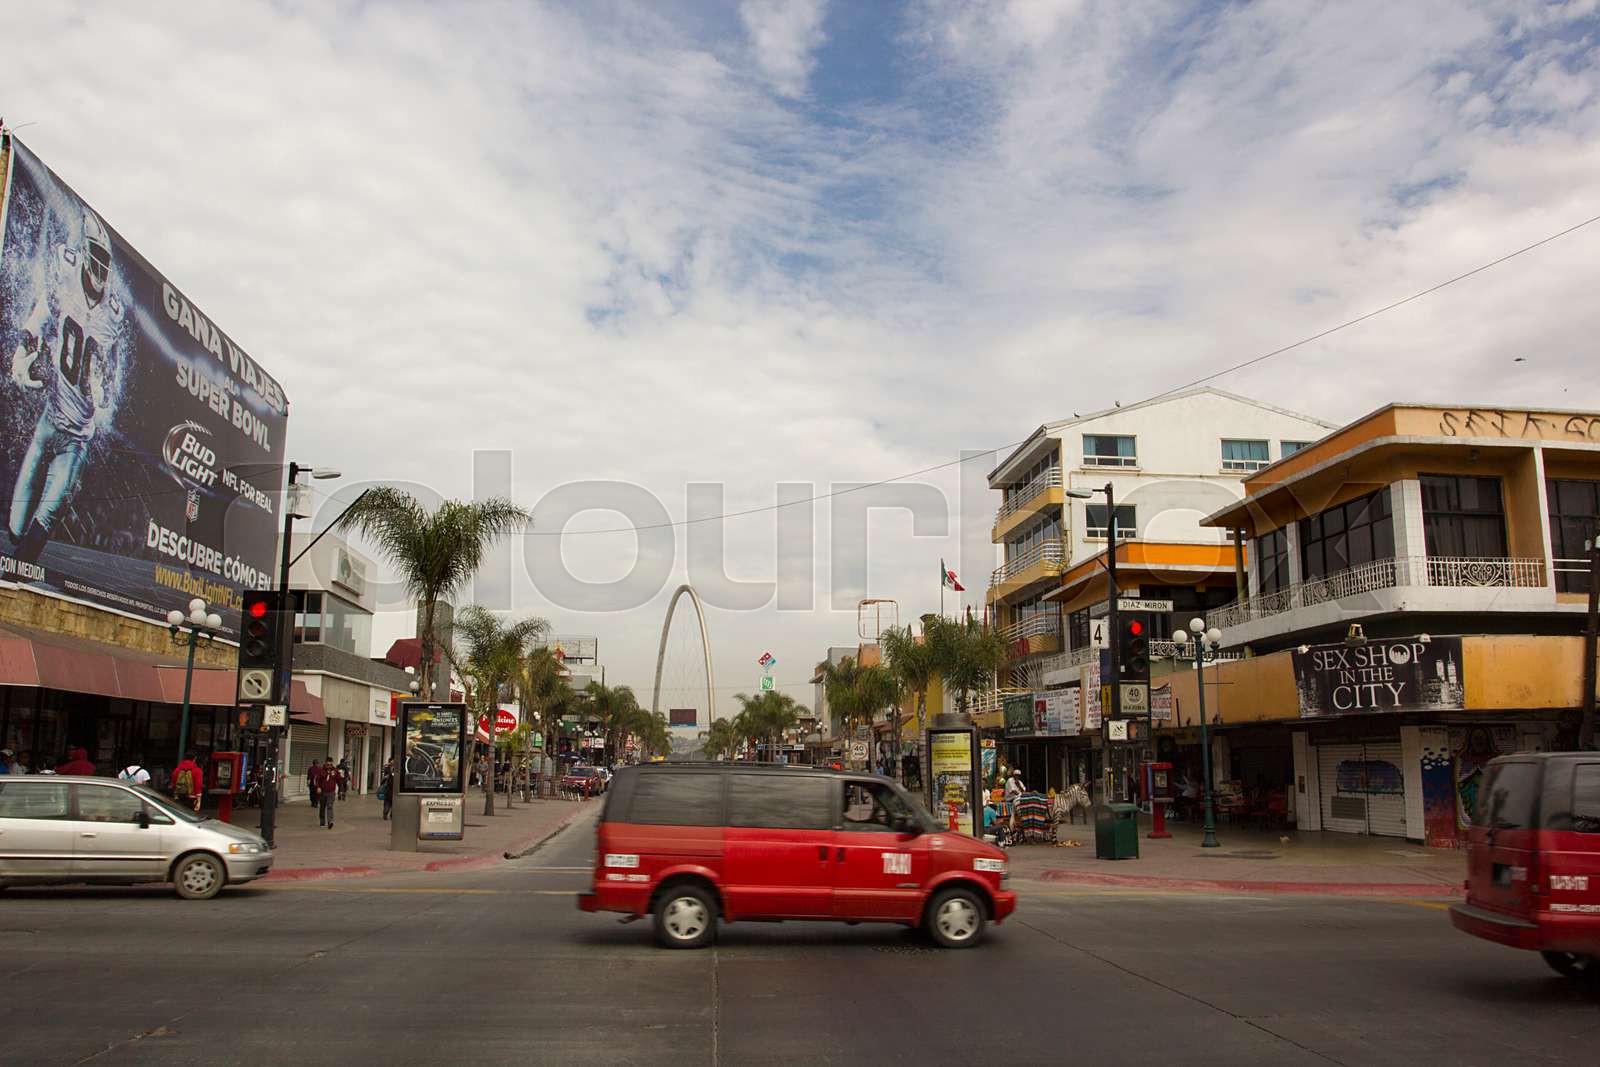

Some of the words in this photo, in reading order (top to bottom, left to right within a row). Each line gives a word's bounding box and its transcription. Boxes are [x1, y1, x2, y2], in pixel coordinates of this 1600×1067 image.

[163, 282, 223, 362] GANA
[223, 337, 285, 413] VIAJES
[176, 359, 229, 420] SUPER
[232, 400, 271, 452] BOWL
[181, 432, 216, 467] BUD
[171, 448, 218, 487] LIGHT
[222, 468, 239, 492] NFL
[240, 480, 256, 502] FOR
[255, 491, 272, 515] REAL
[0, 556, 16, 574] CON
[17, 560, 45, 581] MEDIDA
[224, 555, 257, 589] CÓMO
[258, 571, 271, 591] EN
[1122, 601, 1141, 609] DIAZ
[1094, 623, 1103, 645] 4
[1313, 649, 1350, 672] SEX
[1355, 643, 1425, 668] SHOP
[1340, 669, 1356, 684] IN
[1358, 666, 1394, 682] THE
[1129, 688, 1139, 697] 40
[1332, 682, 1406, 710] CITY
